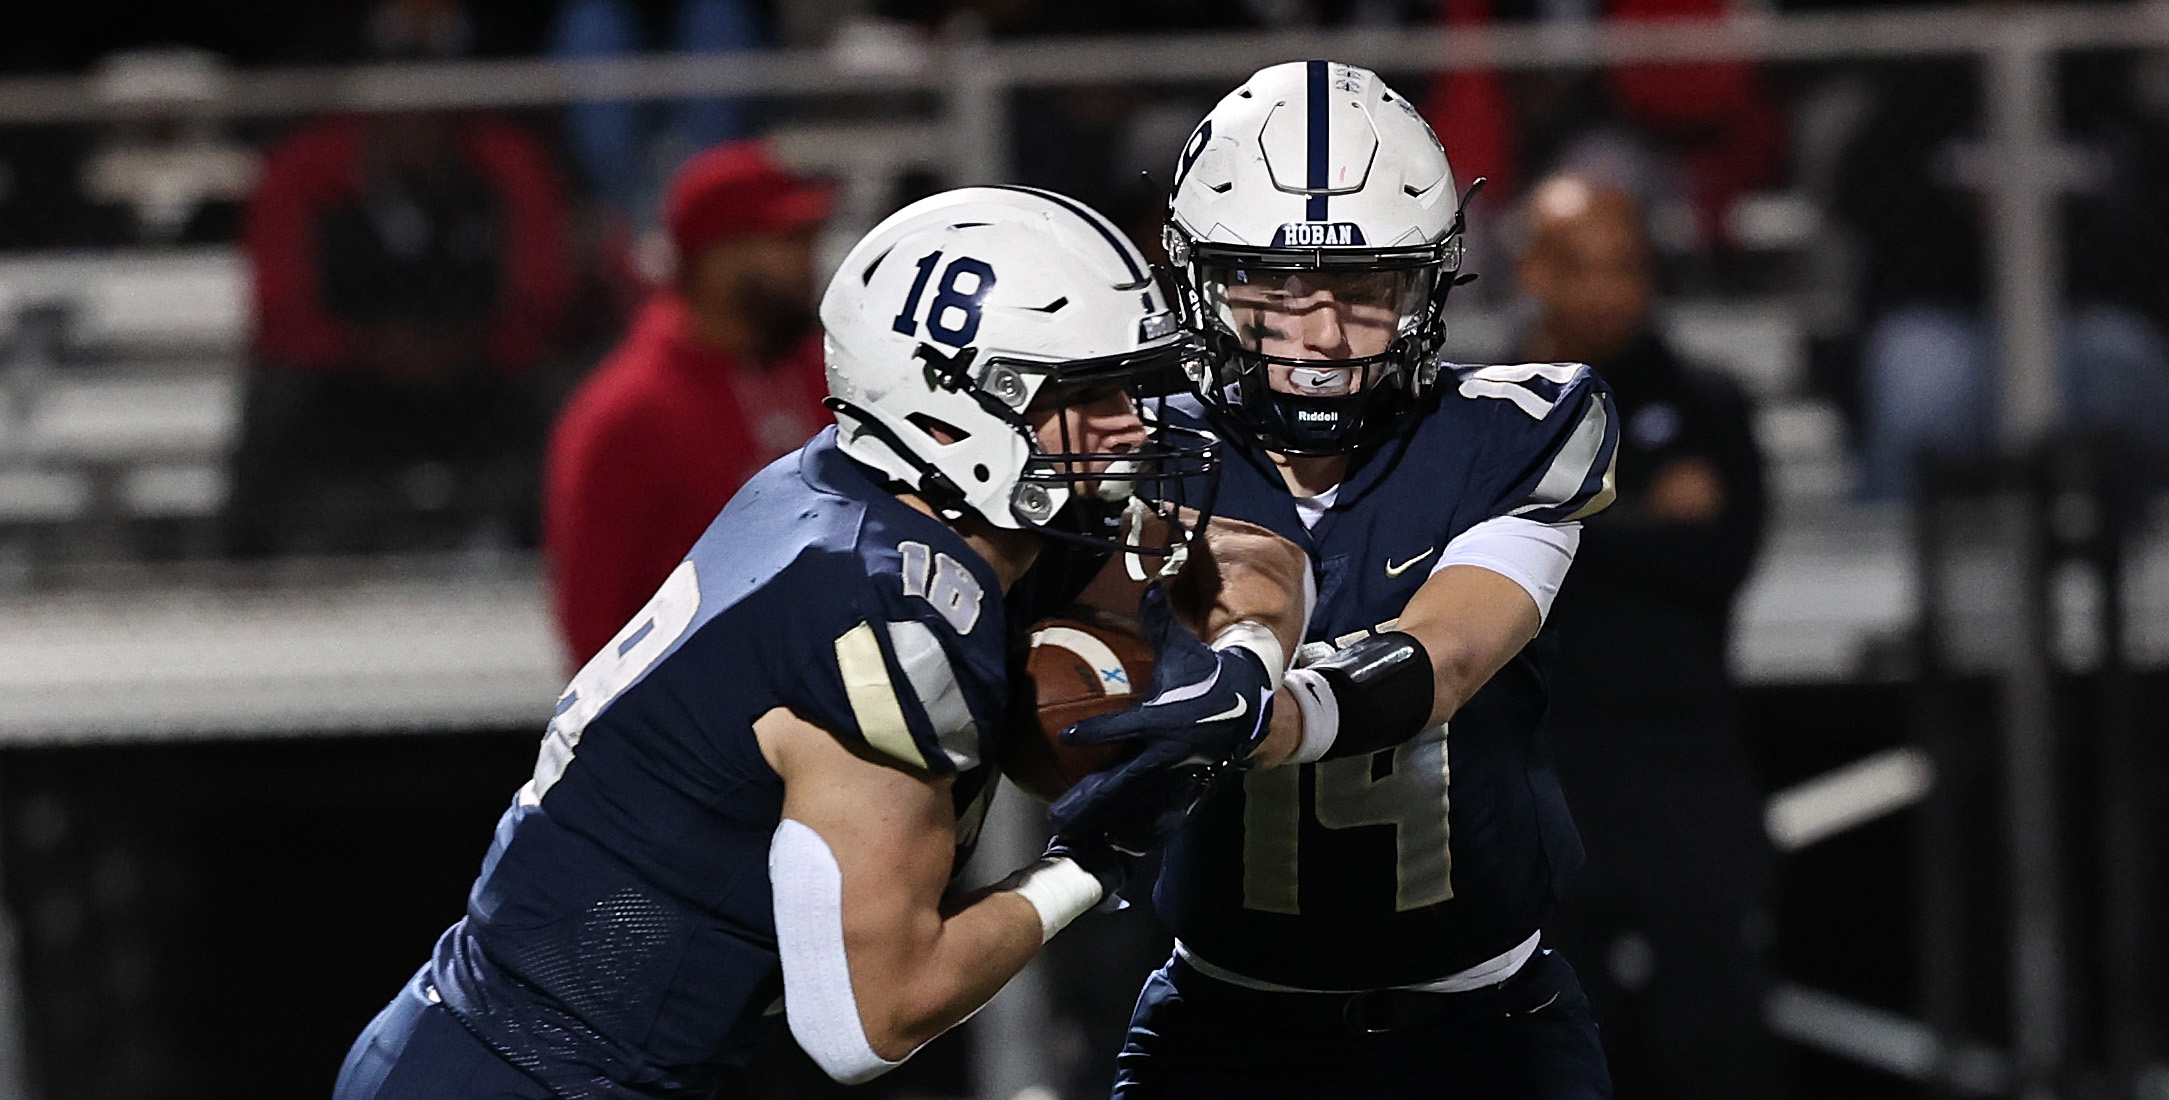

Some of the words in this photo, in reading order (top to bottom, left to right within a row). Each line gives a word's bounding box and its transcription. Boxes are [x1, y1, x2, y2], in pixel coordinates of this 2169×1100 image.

[1283, 224, 1352, 246] HOBAN
[892, 250, 996, 348] 18
[1298, 410, 1339, 421] Riddell
[897, 540, 985, 635] 18
